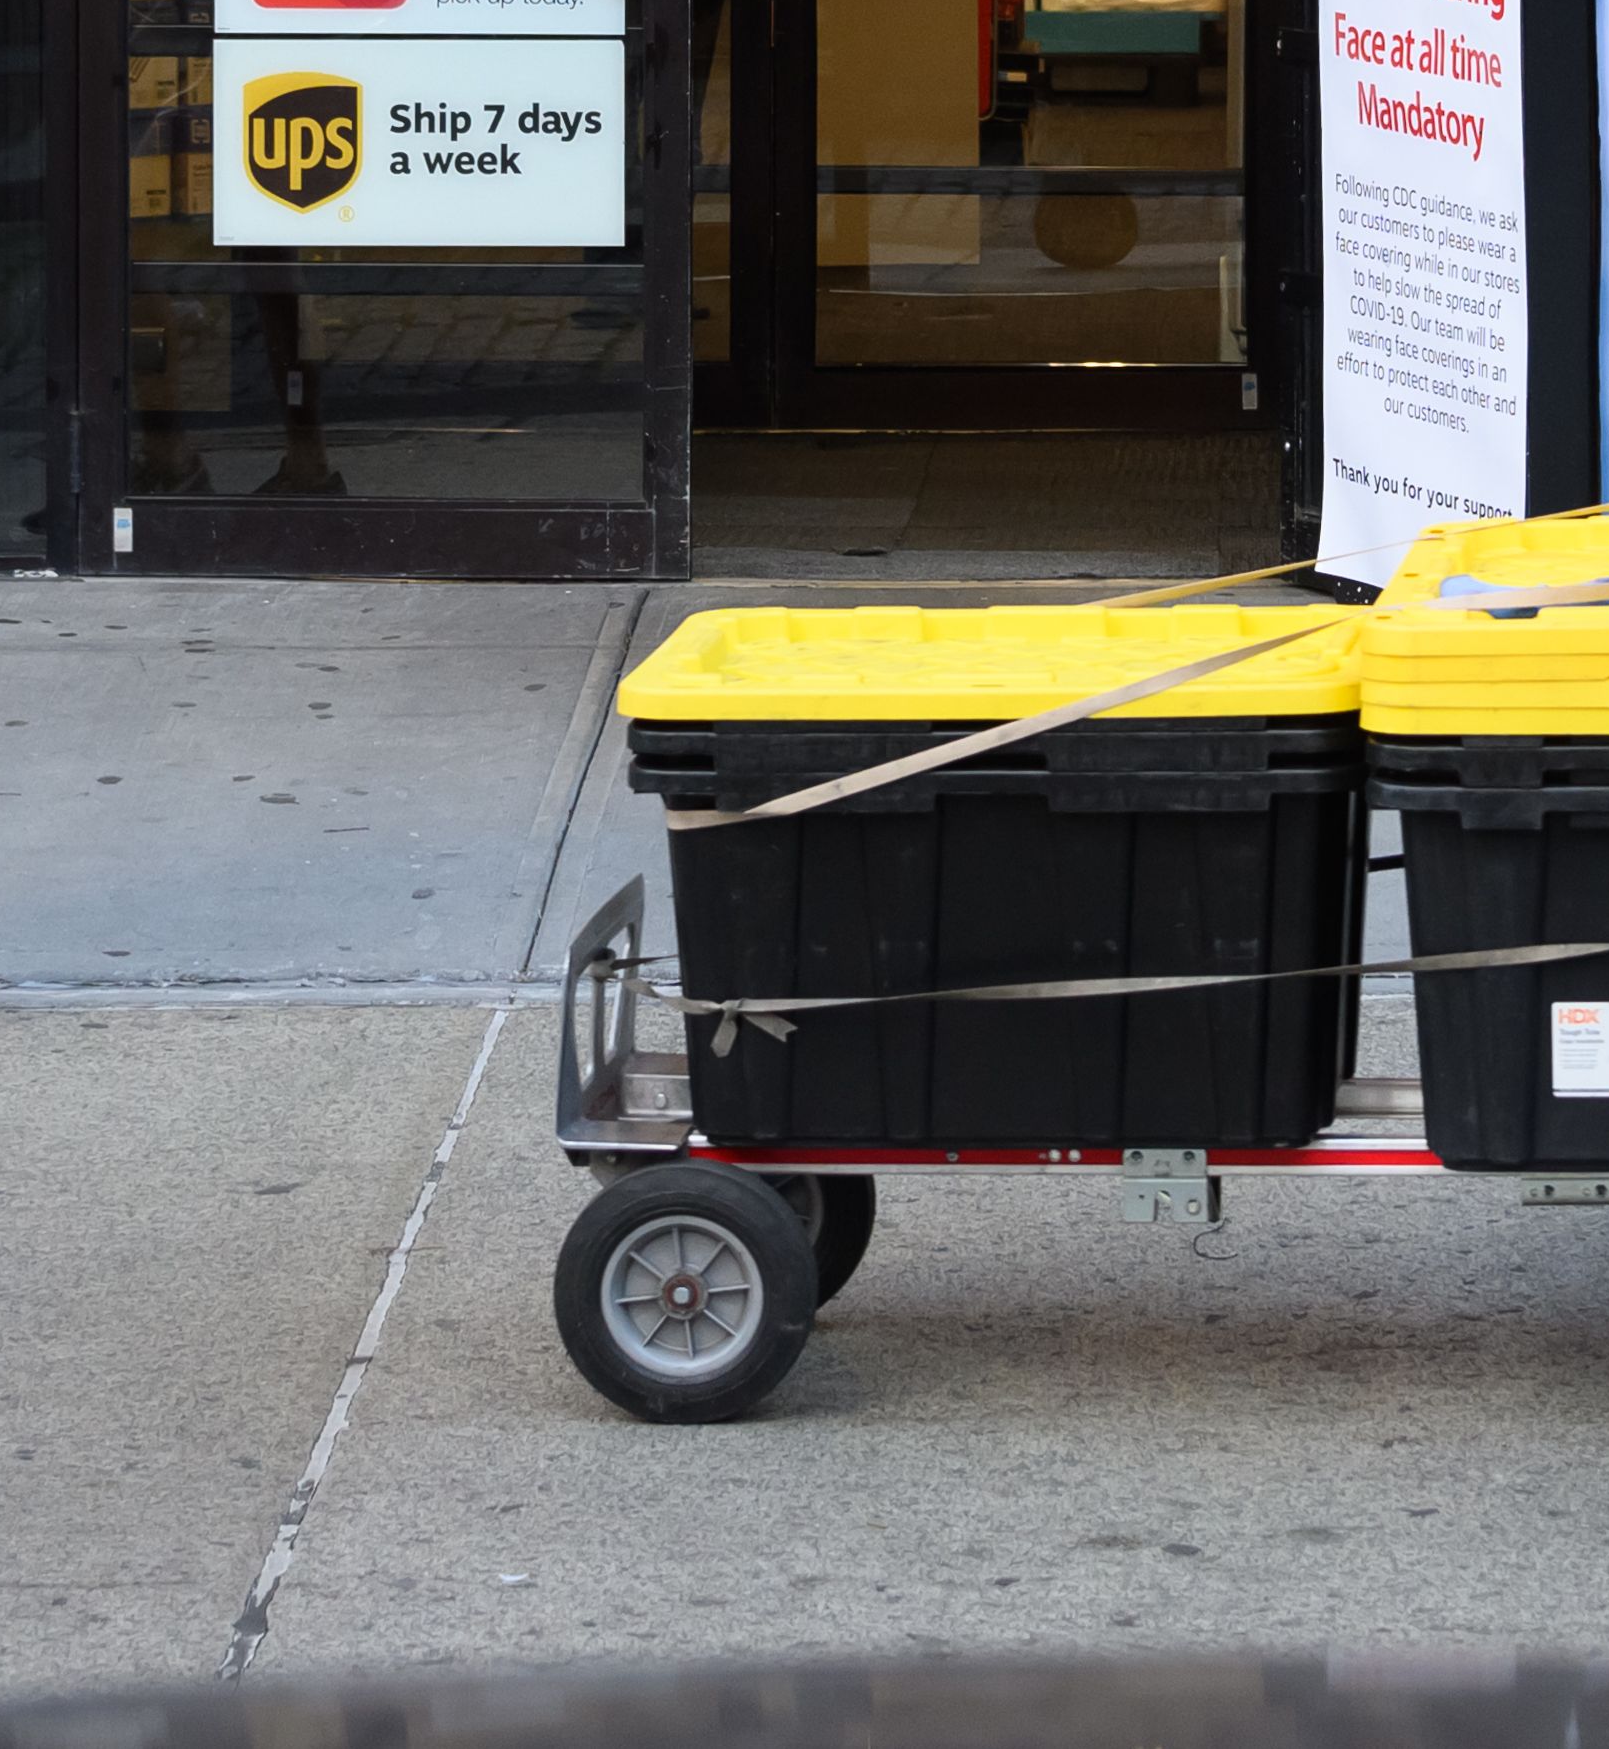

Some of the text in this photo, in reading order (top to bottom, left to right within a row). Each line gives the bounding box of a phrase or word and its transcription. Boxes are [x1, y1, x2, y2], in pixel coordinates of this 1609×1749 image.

[1334, 11, 1502, 88] Face at all time
[389, 102, 603, 142] Ship 7 days
[1357, 80, 1485, 162] Mandatory
[389, 143, 523, 175] a week
[1335, 173, 1518, 233] Following CDC guidance, we ask
[1335, 231, 1520, 294] face covering while in our stores
[1338, 208, 1516, 263] our customers to please wear a
[1353, 268, 1502, 320] to help slow the spread of
[1350, 294, 1505, 352] COVID-19. Our team will be
[1347, 327, 1507, 383] wearing face coverings in an
[1336, 351, 1517, 416] effort to protect each other and
[1384, 397, 1470, 434] our customers.
[1332, 457, 1371, 487] Thank
[1374, 474, 1399, 494] you
[1403, 477, 1422, 501] for
[1426, 488, 1459, 509] your
[1558, 1008, 1600, 1024] HDX
